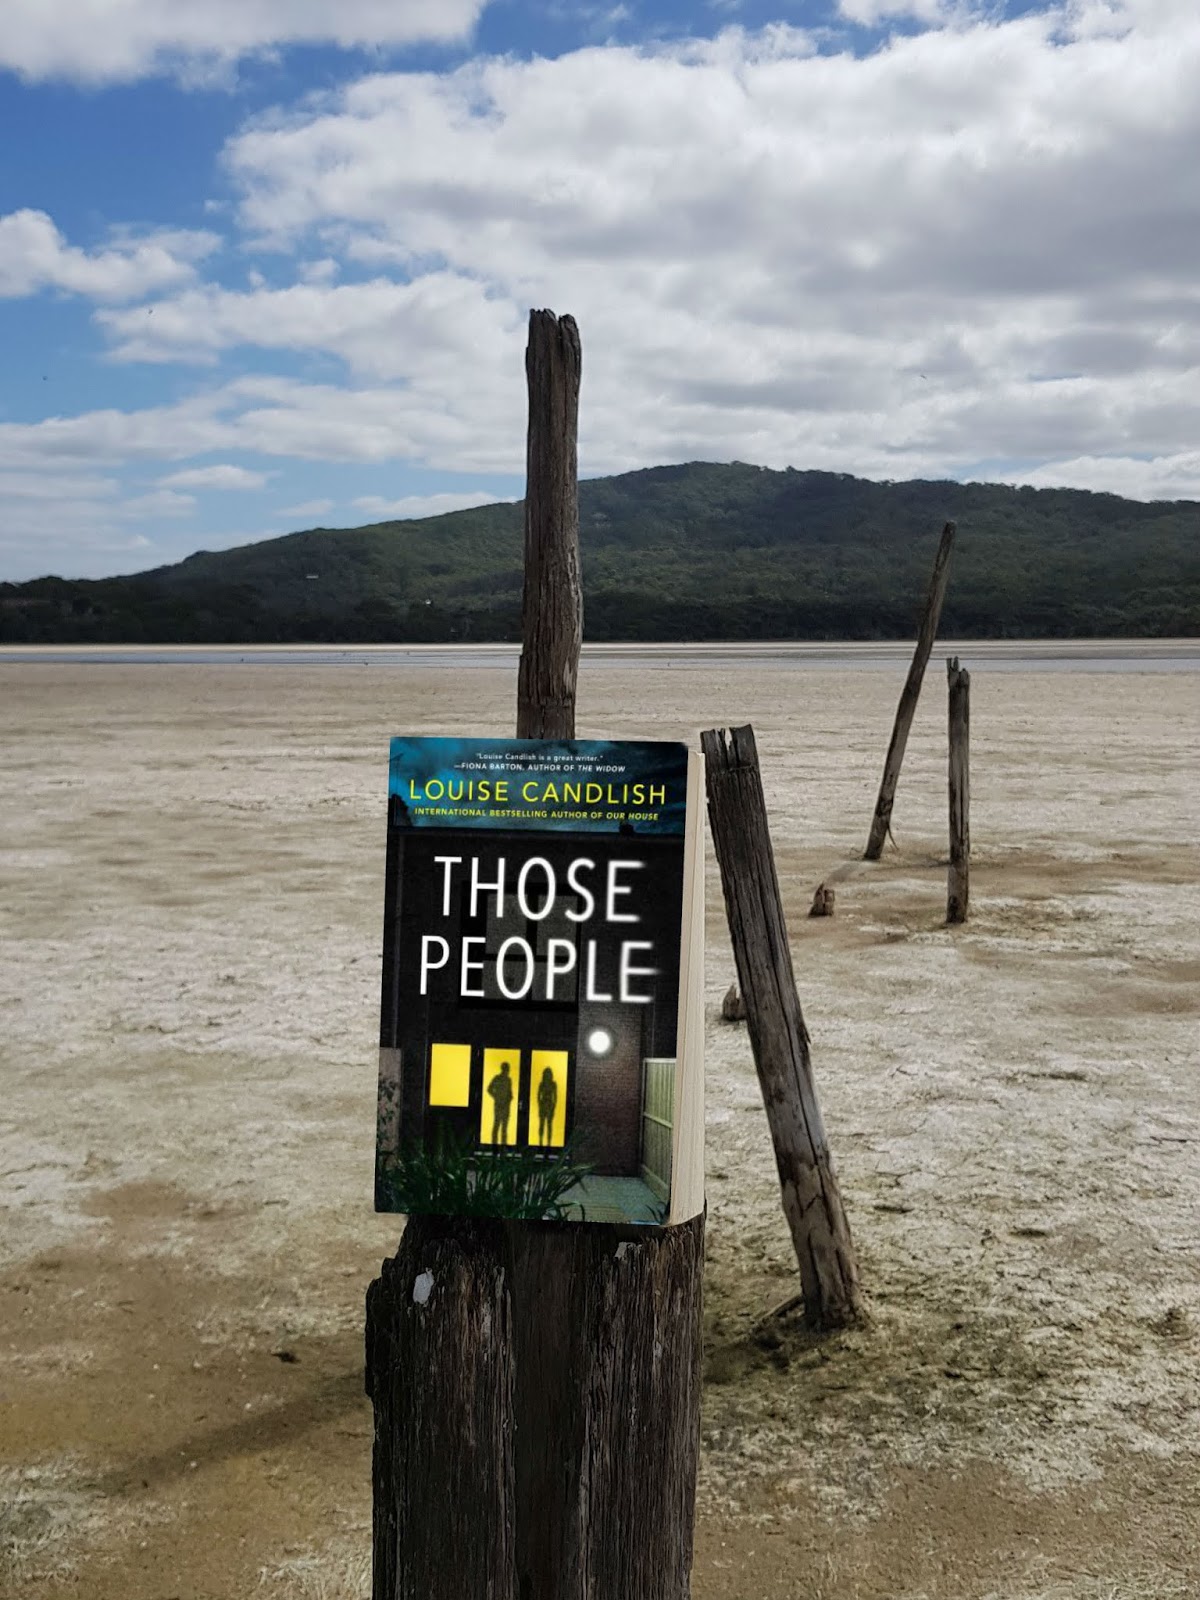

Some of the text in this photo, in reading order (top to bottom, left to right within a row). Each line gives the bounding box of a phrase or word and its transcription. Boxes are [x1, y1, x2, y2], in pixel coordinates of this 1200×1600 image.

[504, 752, 537, 761] Candlish
[538, 753, 545, 761] is
[553, 754, 573, 763] great
[527, 763, 561, 772] AUTHOR
[563, 763, 575, 772] OF
[578, 764, 593, 772] THE
[595, 764, 626, 773] WIDOW
[409, 779, 666, 805] LOUISE CANDLISH
[414, 807, 659, 821] INTERNATIONAL BESTSELLING AUTHOR OF OUR HOUSE
[434, 856, 646, 922] THOSE
[420, 935, 661, 1004] PEOPLE
